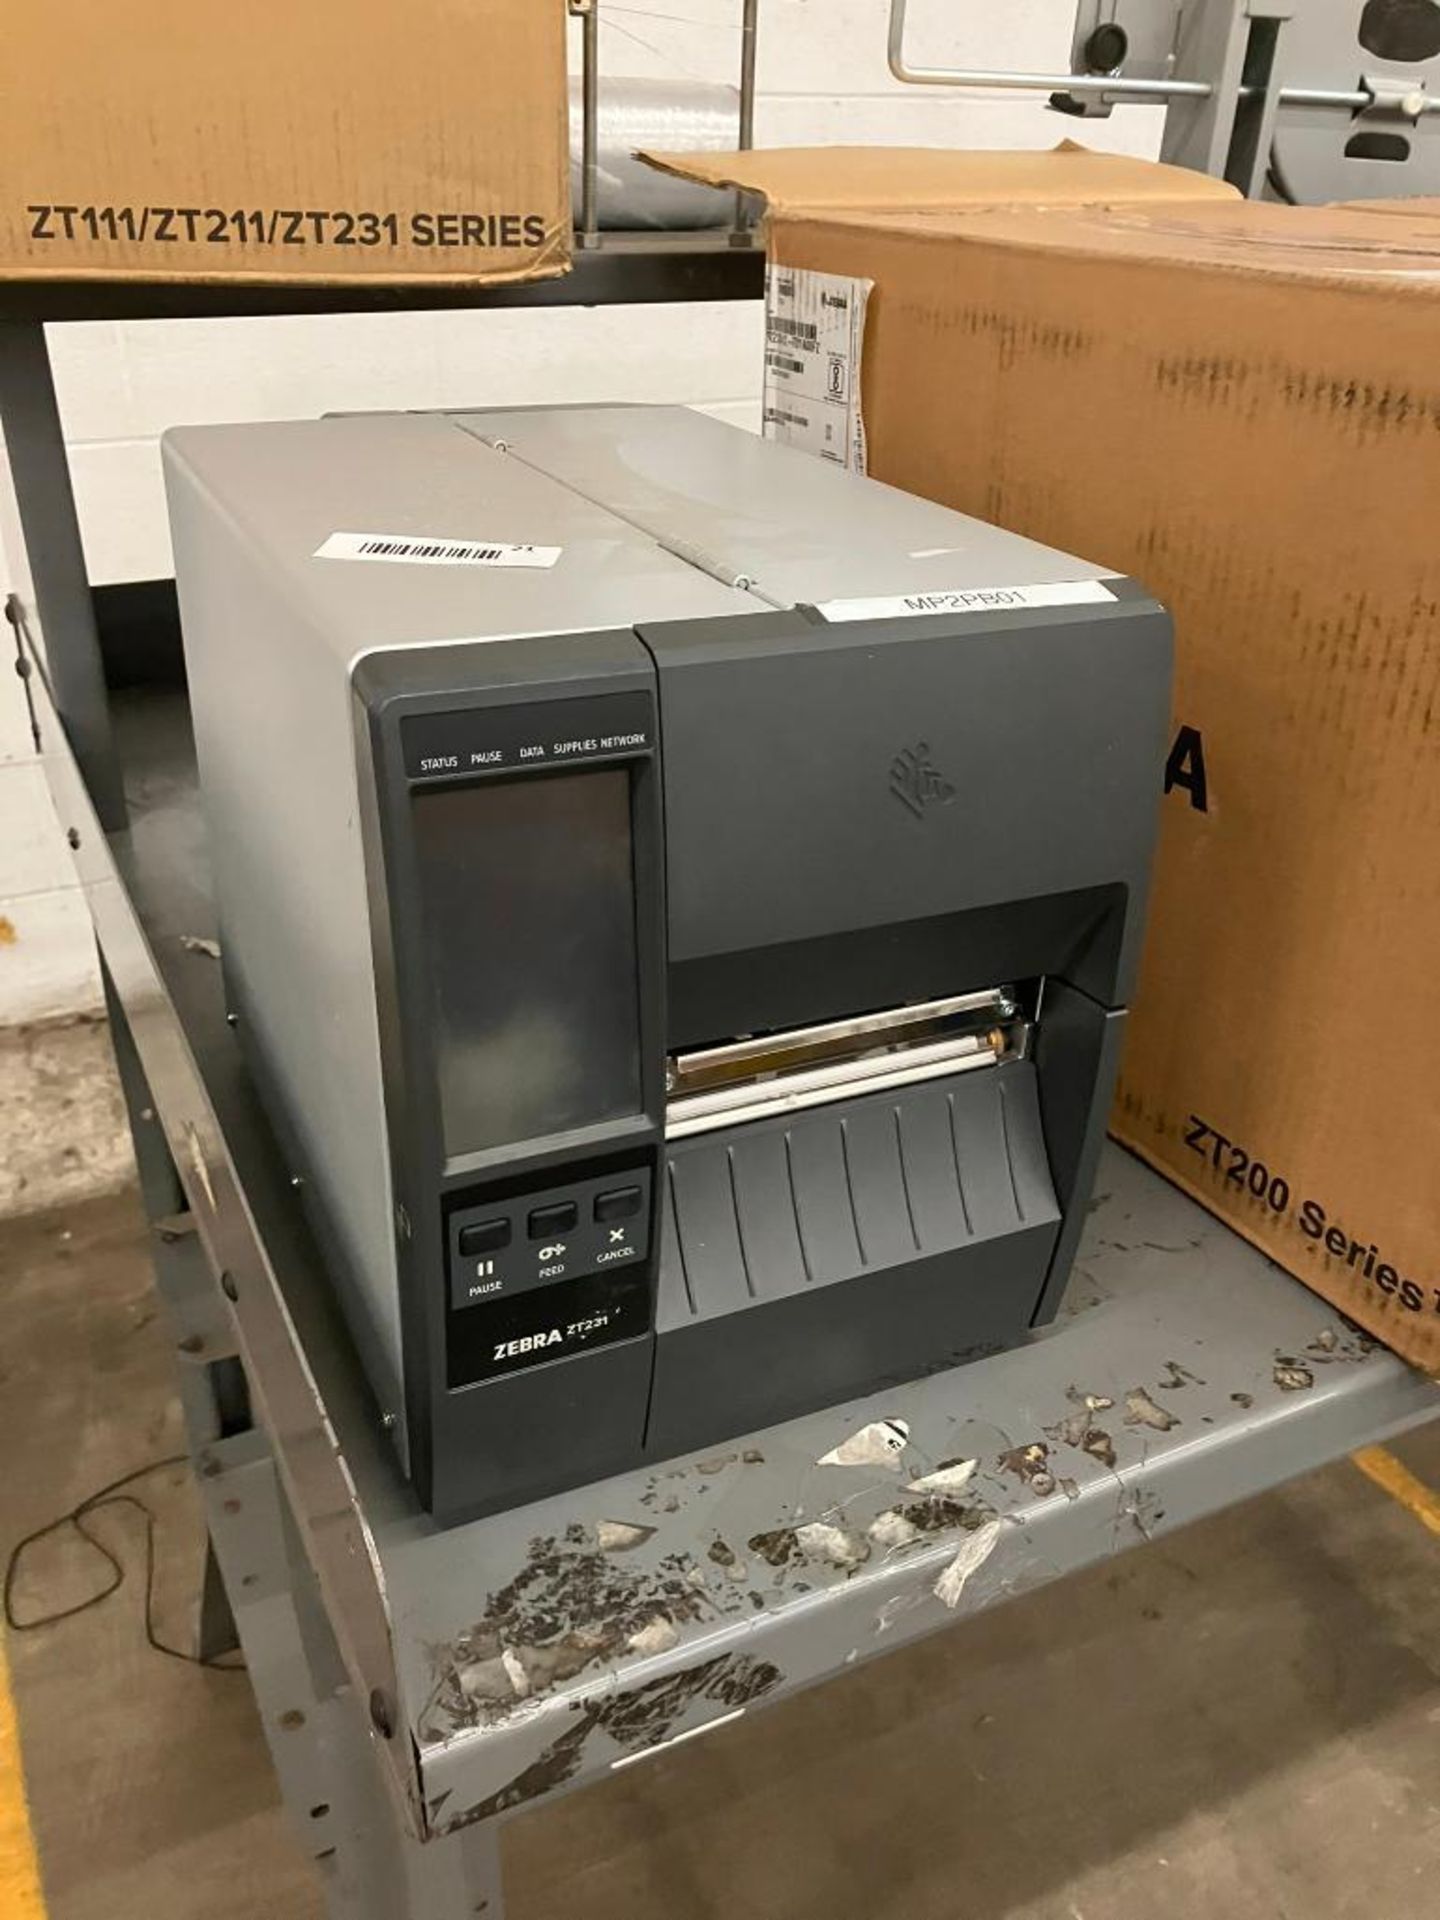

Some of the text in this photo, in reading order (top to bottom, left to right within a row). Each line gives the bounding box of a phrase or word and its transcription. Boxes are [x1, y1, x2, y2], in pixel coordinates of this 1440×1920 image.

[27, 205, 546, 248] ZT111/ZT211/ZT231 SERIES
[420, 733, 646, 771] STATUS PAUSE DATA SUPPLIES NETWORK
[1183, 1114, 1424, 1312] ZT200 Series
[469, 1246, 637, 1297] PAUSE FEED CANCEL
[493, 1315, 609, 1361] ZEBRA ZT231
